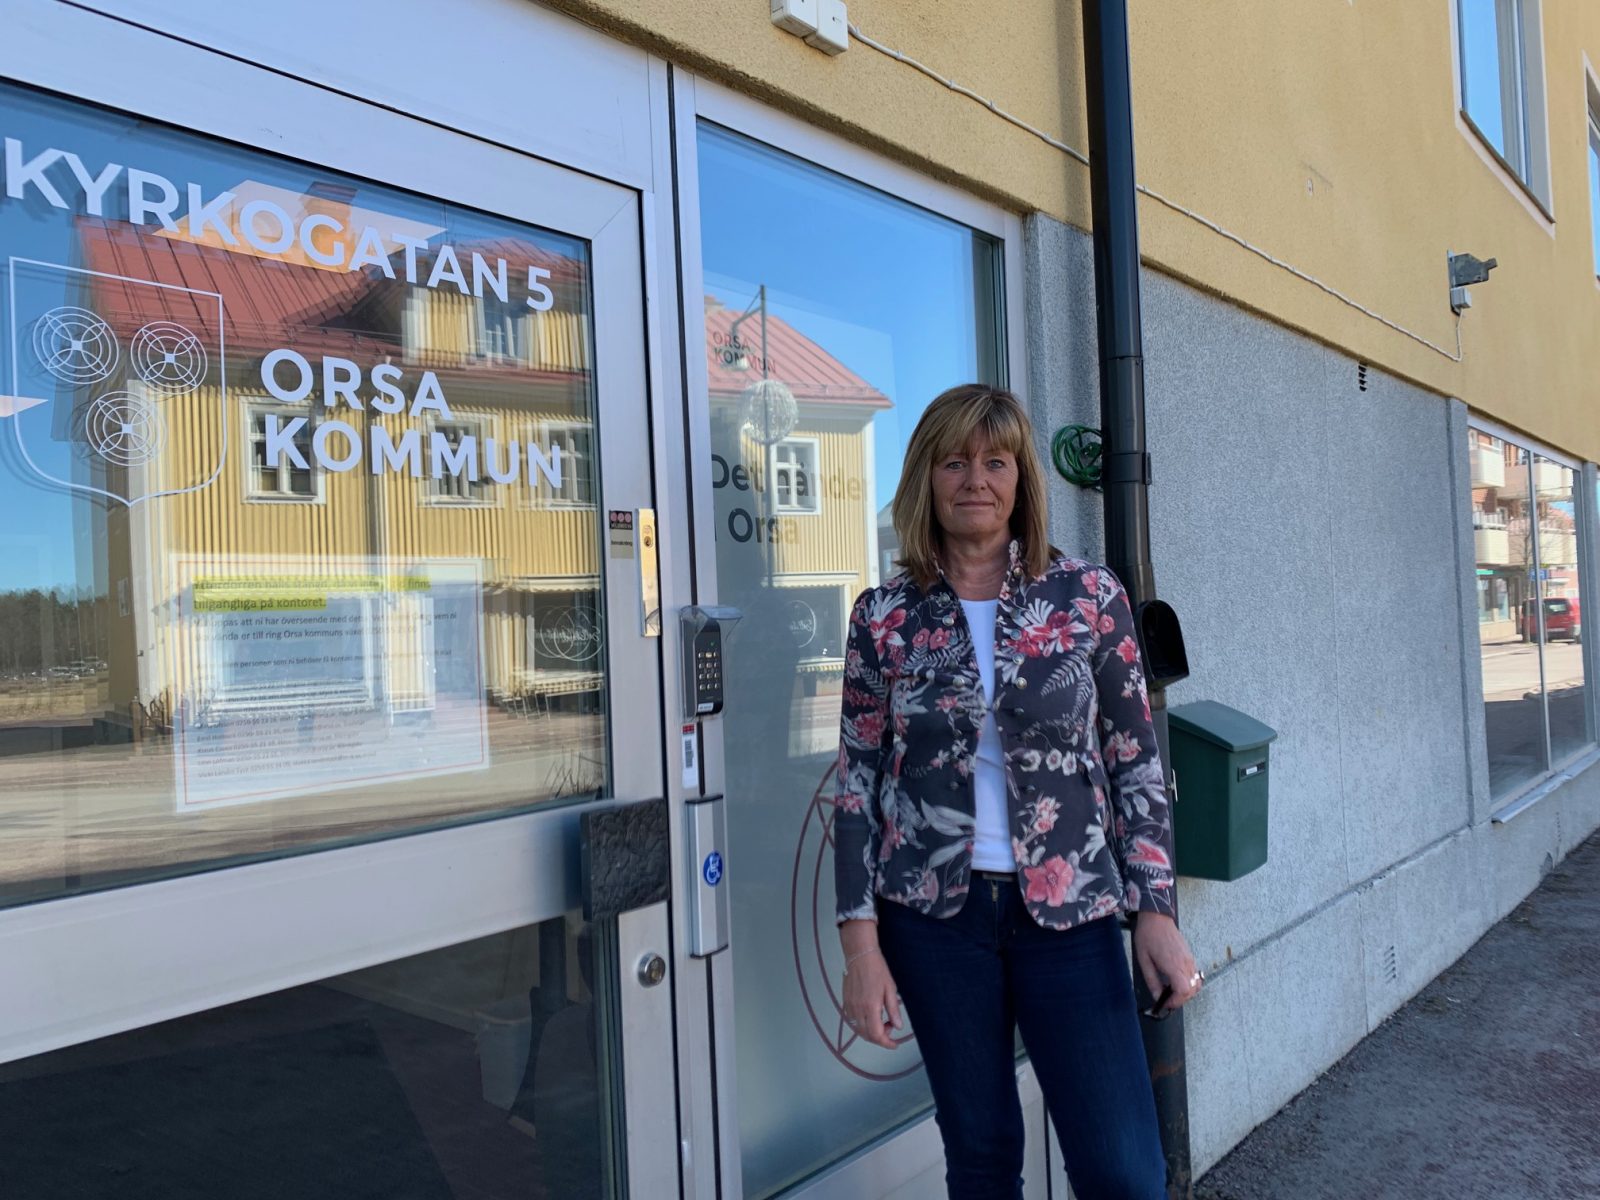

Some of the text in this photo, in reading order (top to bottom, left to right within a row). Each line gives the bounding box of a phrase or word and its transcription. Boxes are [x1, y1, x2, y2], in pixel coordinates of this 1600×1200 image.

[5, 137, 554, 312] KYRKOGATAN 5
[713, 331, 752, 351] ORSA
[714, 348, 777, 374] KOMMUN
[260, 348, 452, 421] ORSA
[264, 414, 563, 489] KOMMUN
[711, 454, 764, 493] Det
[727, 507, 800, 545] Orsa
[283, 628, 303, 638] Orsa
